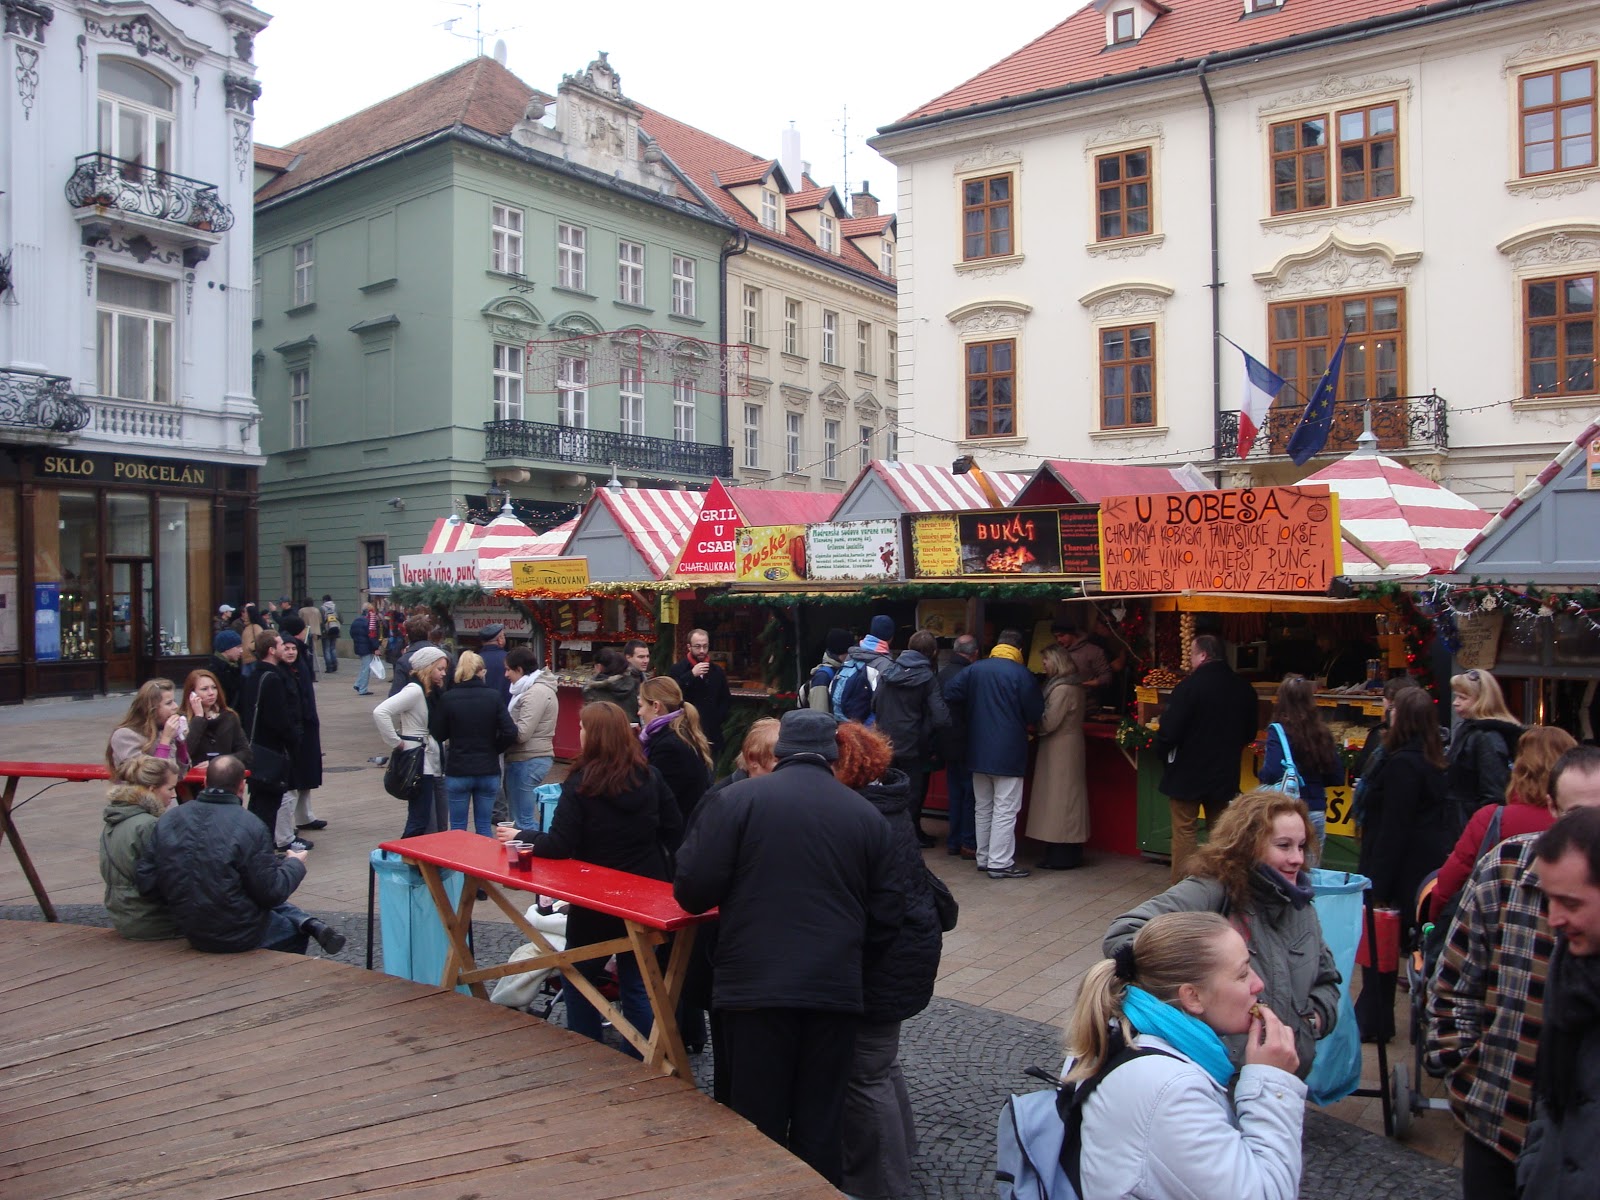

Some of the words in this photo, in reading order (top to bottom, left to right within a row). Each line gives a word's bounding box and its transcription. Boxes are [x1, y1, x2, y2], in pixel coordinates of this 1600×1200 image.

[45, 456, 95, 475] SKLO
[114, 461, 205, 484] PORCELÁN
[1135, 497, 1152, 523] U
[1166, 488, 1289, 525] BOBEŠA
[700, 508, 737, 521] GRIL
[714, 525, 724, 537] U
[698, 540, 736, 553] CSAB
[402, 561, 432, 583] Varené
[457, 559, 476, 583] punč
[680, 561, 737, 572] CHATEAUKRAK
